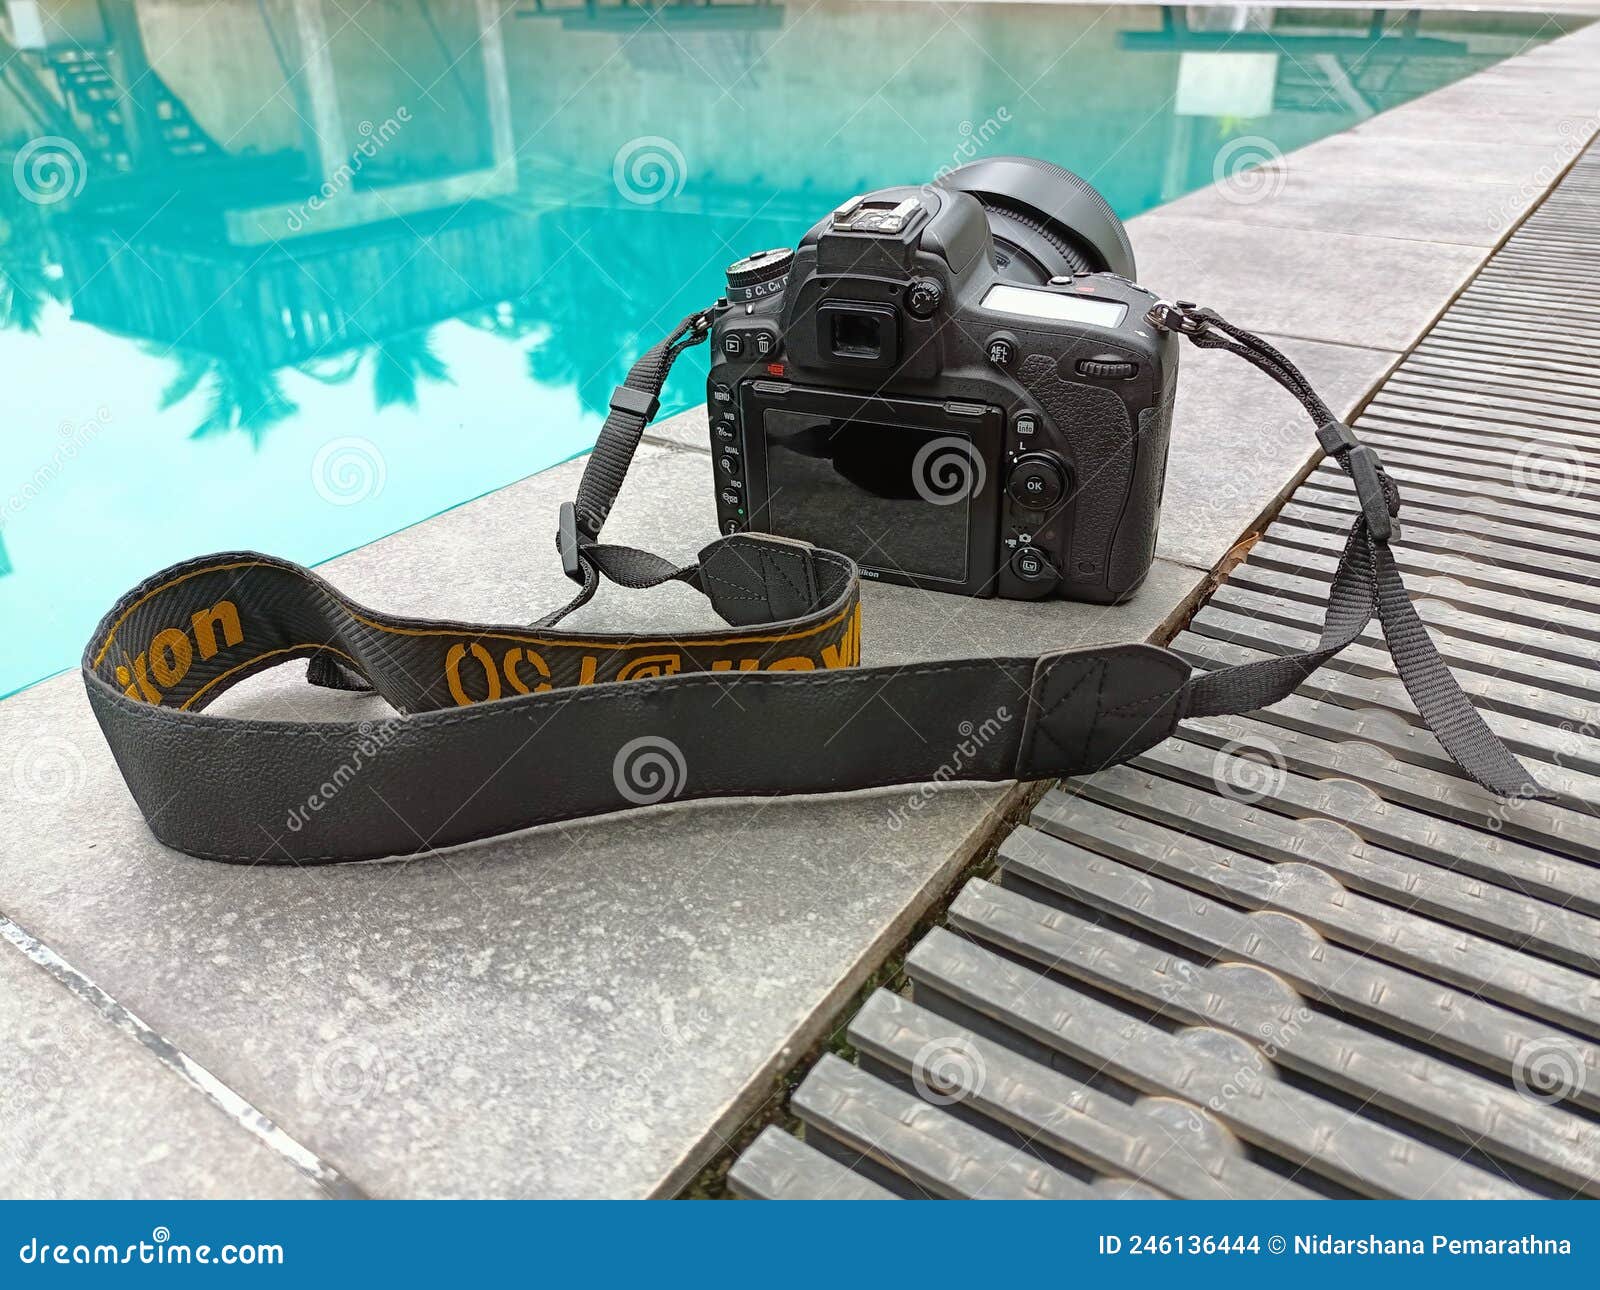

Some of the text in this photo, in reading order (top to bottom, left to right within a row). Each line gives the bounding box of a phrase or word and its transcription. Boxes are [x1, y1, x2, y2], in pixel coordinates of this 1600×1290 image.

[714, 391, 730, 401] MENU
[724, 412, 735, 421] WB
[724, 446, 740, 455] QUAL
[1019, 441, 1026, 451] L
[730, 480, 742, 488] ISO
[1027, 482, 1043, 491] OK
[116, 600, 244, 706] ikon
